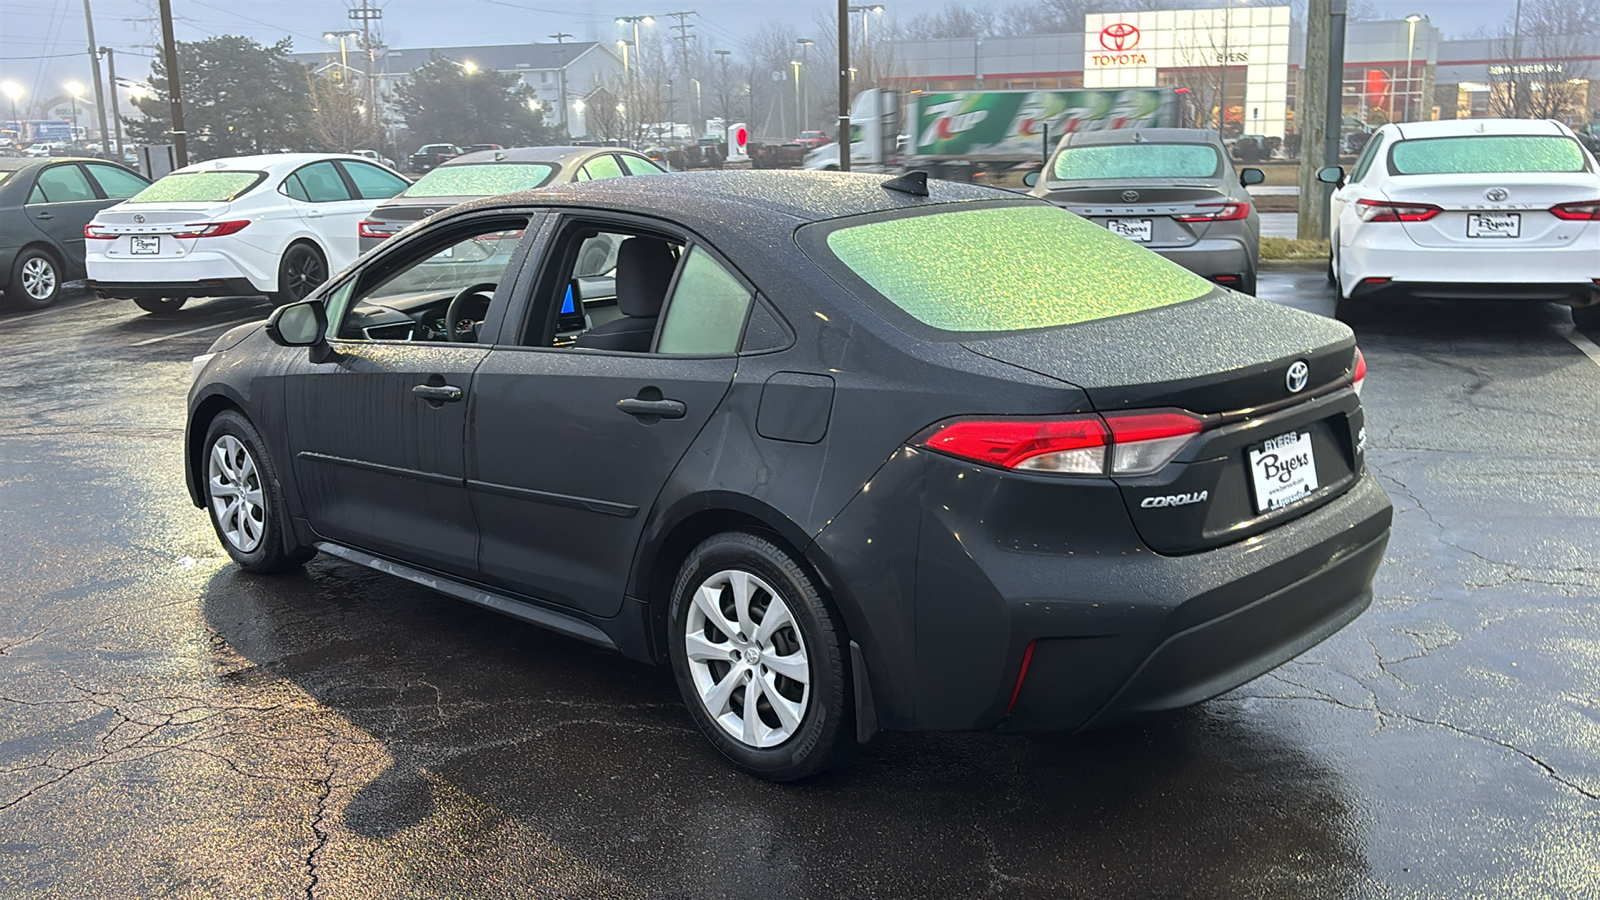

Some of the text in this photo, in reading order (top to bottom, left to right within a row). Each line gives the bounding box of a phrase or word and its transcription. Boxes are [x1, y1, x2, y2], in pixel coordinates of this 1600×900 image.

[1092, 54, 1147, 66] TOYOTA
[1264, 431, 1297, 452] BYERS
[1256, 453, 1308, 483] Byers
[1140, 490, 1208, 508] COROLLA
